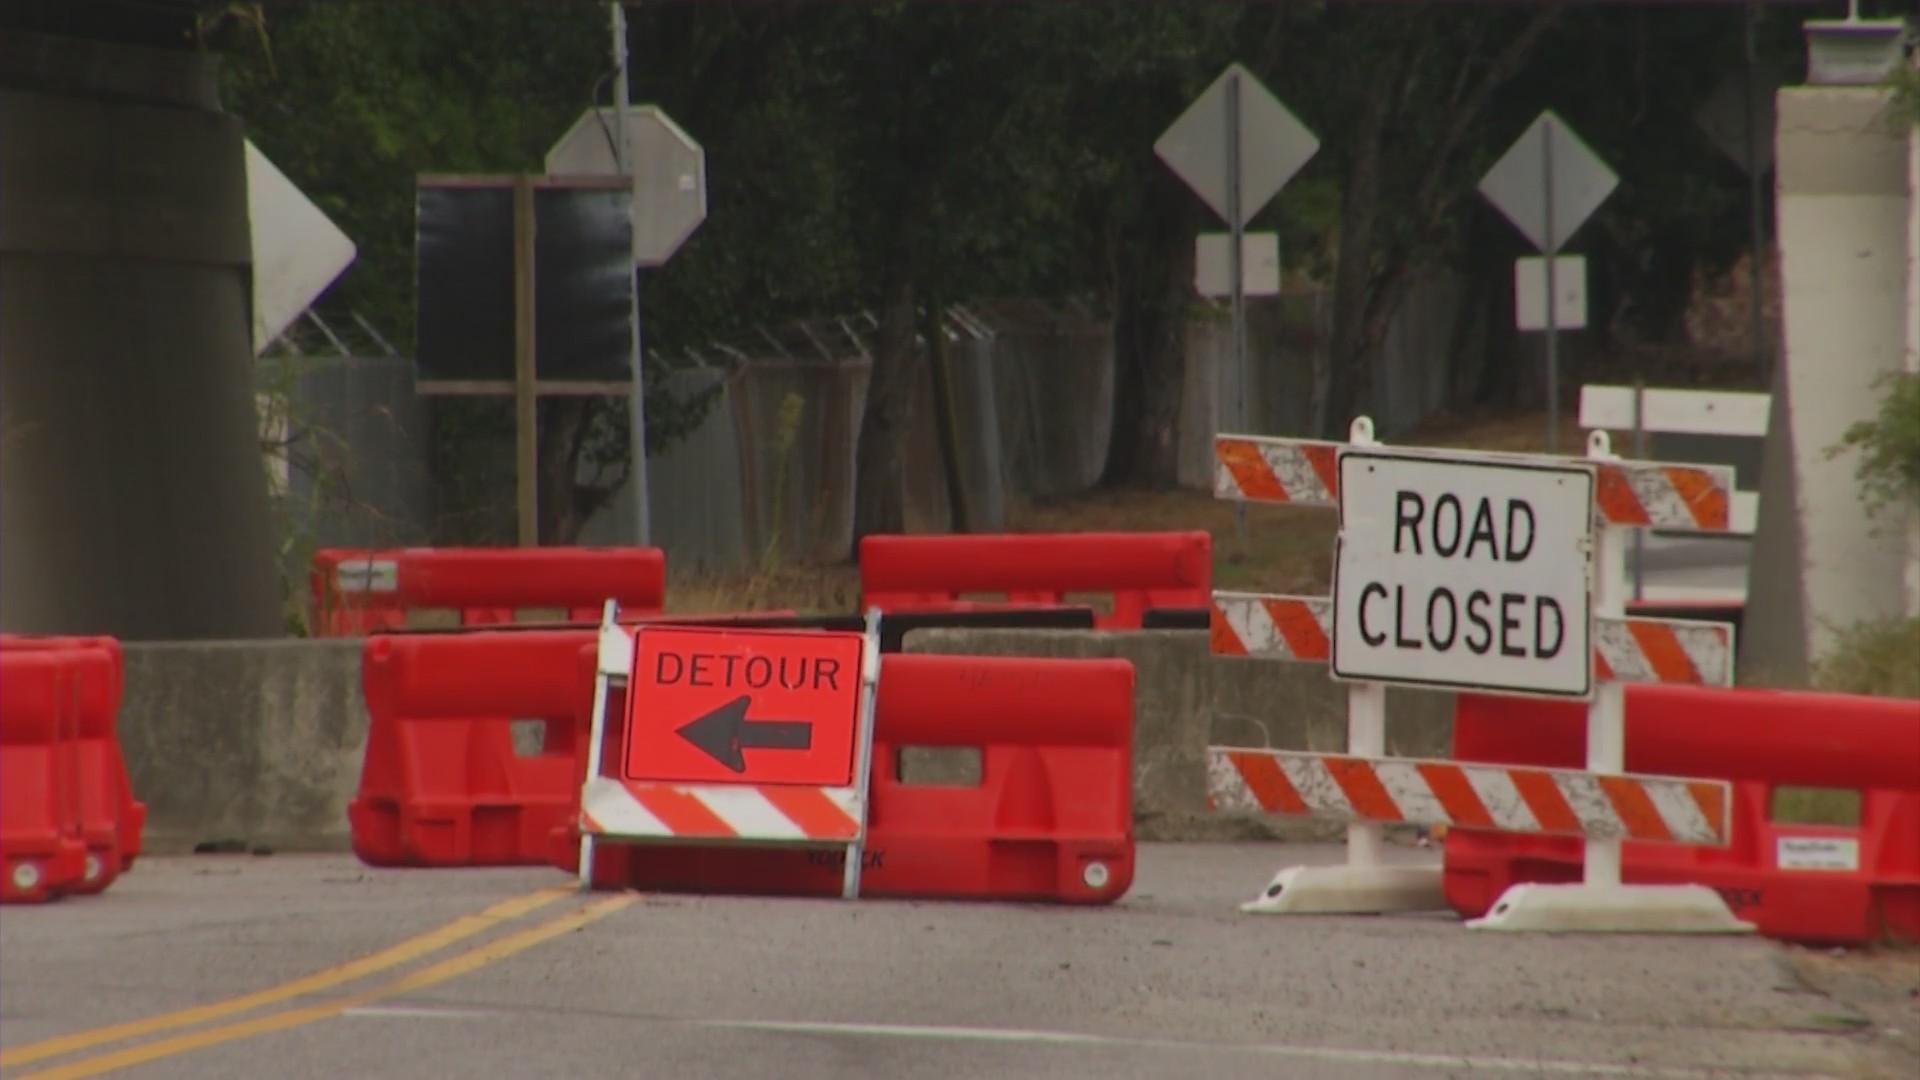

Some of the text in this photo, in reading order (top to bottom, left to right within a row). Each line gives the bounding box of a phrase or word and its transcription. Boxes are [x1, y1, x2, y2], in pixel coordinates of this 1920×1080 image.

[1394, 490, 1536, 562] ROAD
[1358, 581, 1565, 660] CLOSED
[656, 652, 840, 690] DETOUR
